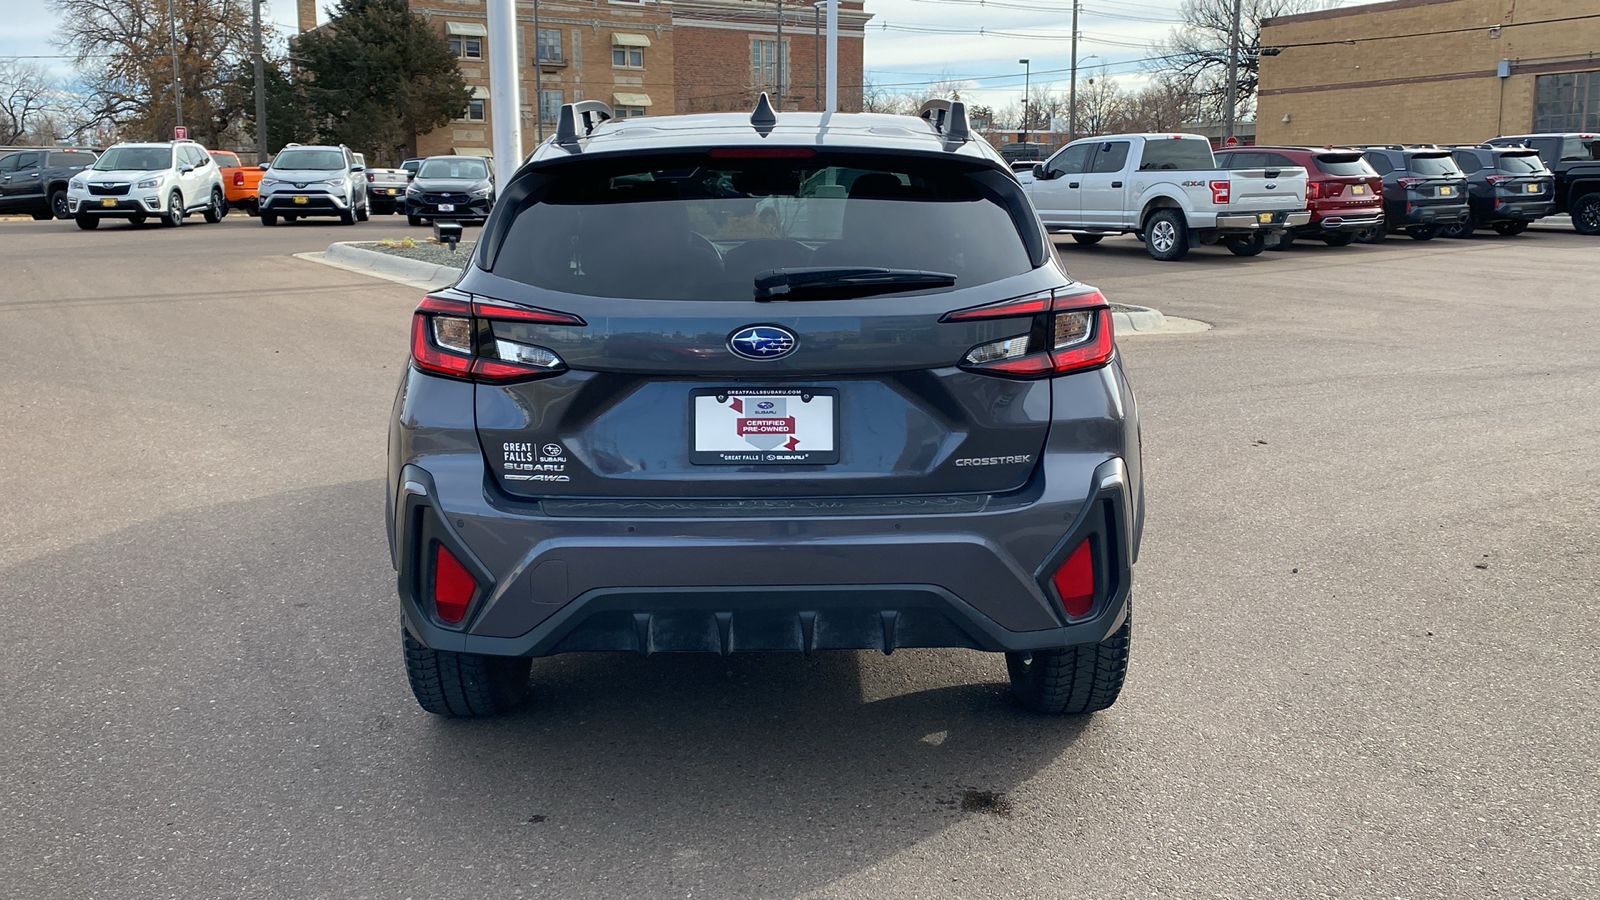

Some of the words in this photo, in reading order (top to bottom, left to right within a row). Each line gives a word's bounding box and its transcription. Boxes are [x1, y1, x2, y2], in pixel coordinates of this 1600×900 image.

[503, 442, 532, 452] GREAT
[504, 452, 532, 462] FALLS
[956, 454, 1030, 466] CROSSTREK
[504, 462, 564, 472] SUBARU
